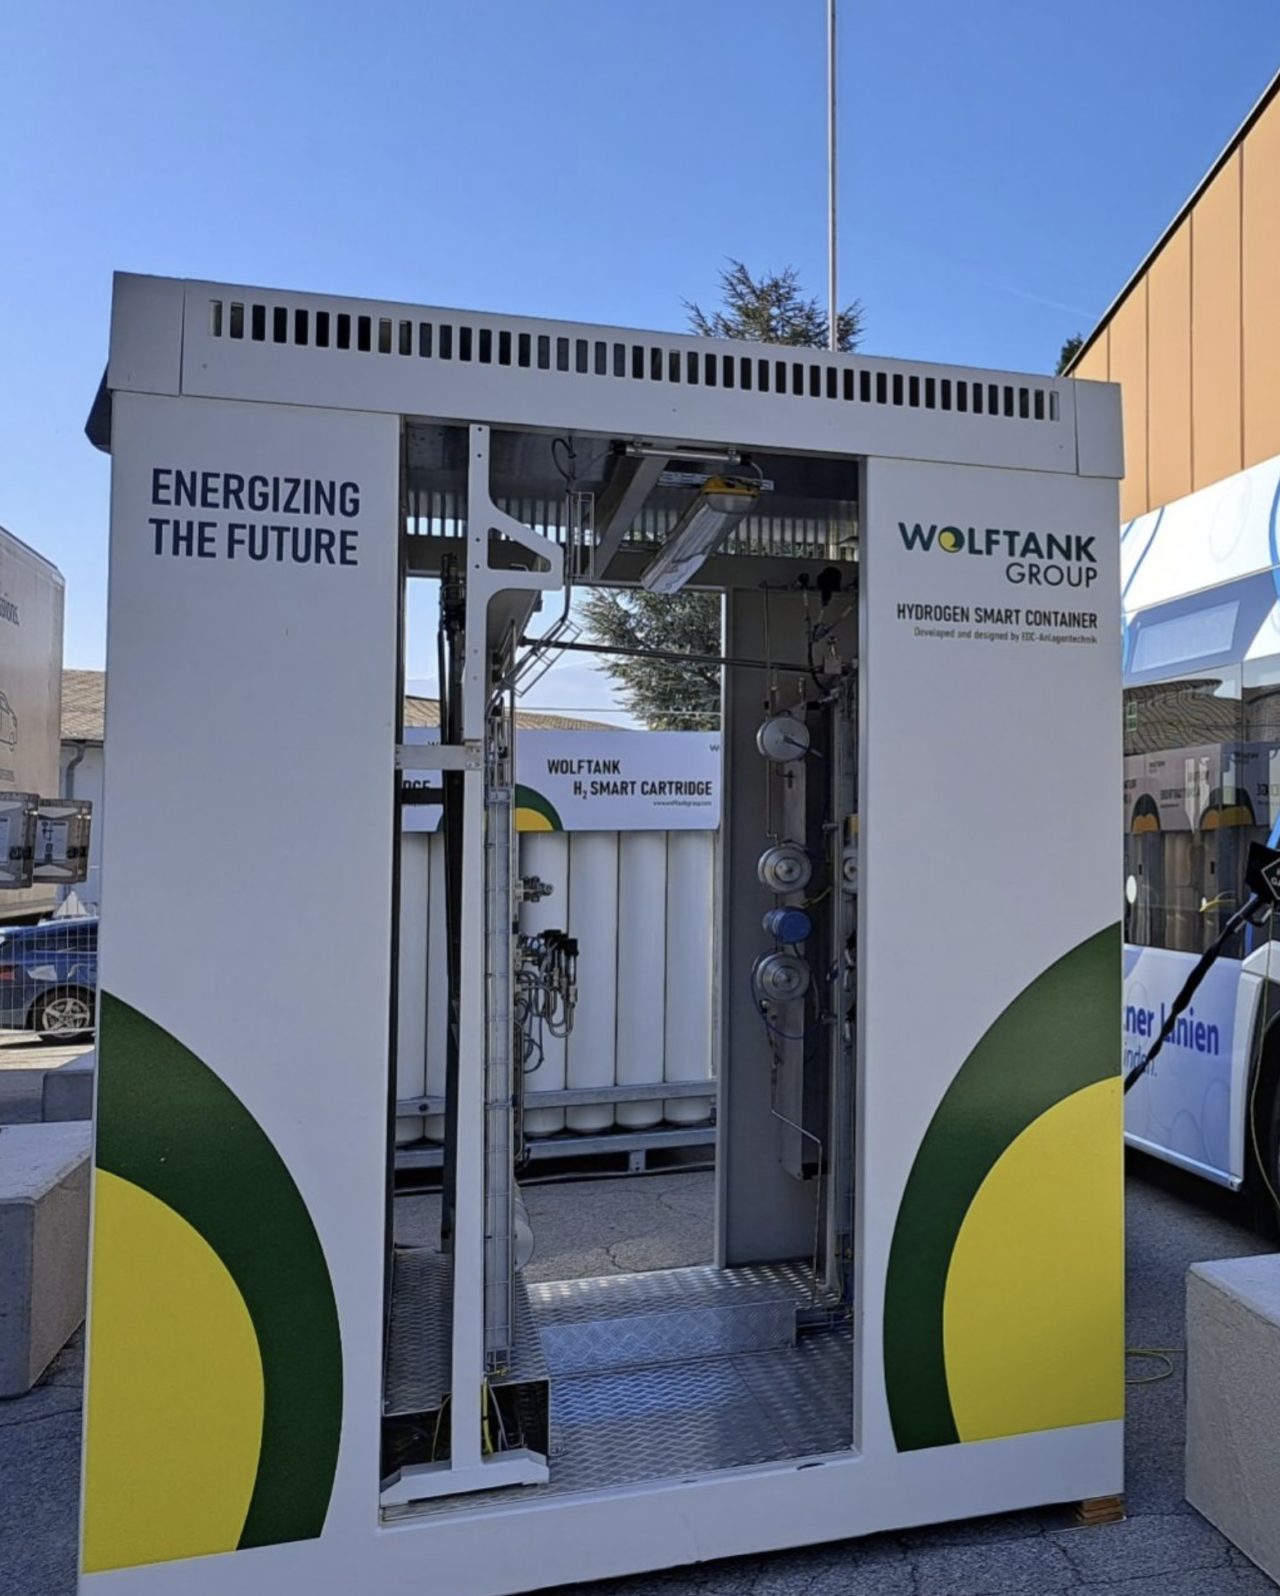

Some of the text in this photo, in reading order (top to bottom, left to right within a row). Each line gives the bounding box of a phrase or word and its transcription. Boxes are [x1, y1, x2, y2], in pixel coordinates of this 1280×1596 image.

[151, 467, 360, 518] ENERGIZING
[148, 517, 359, 566] THE FUTURE
[897, 521, 1098, 563] WOLFTANK
[1005, 561, 1098, 588] GROUP
[896, 602, 1098, 629] HYDROGEN SMART CONTAINER
[914, 627, 956, 640] Developed
[957, 629, 972, 639] and
[973, 629, 1009, 642] designed
[1010, 631, 1020, 642] by
[547, 759, 621, 775] WOLFTANK
[590, 780, 636, 796] SMART
[640, 780, 713, 796] CARTRIDGE
